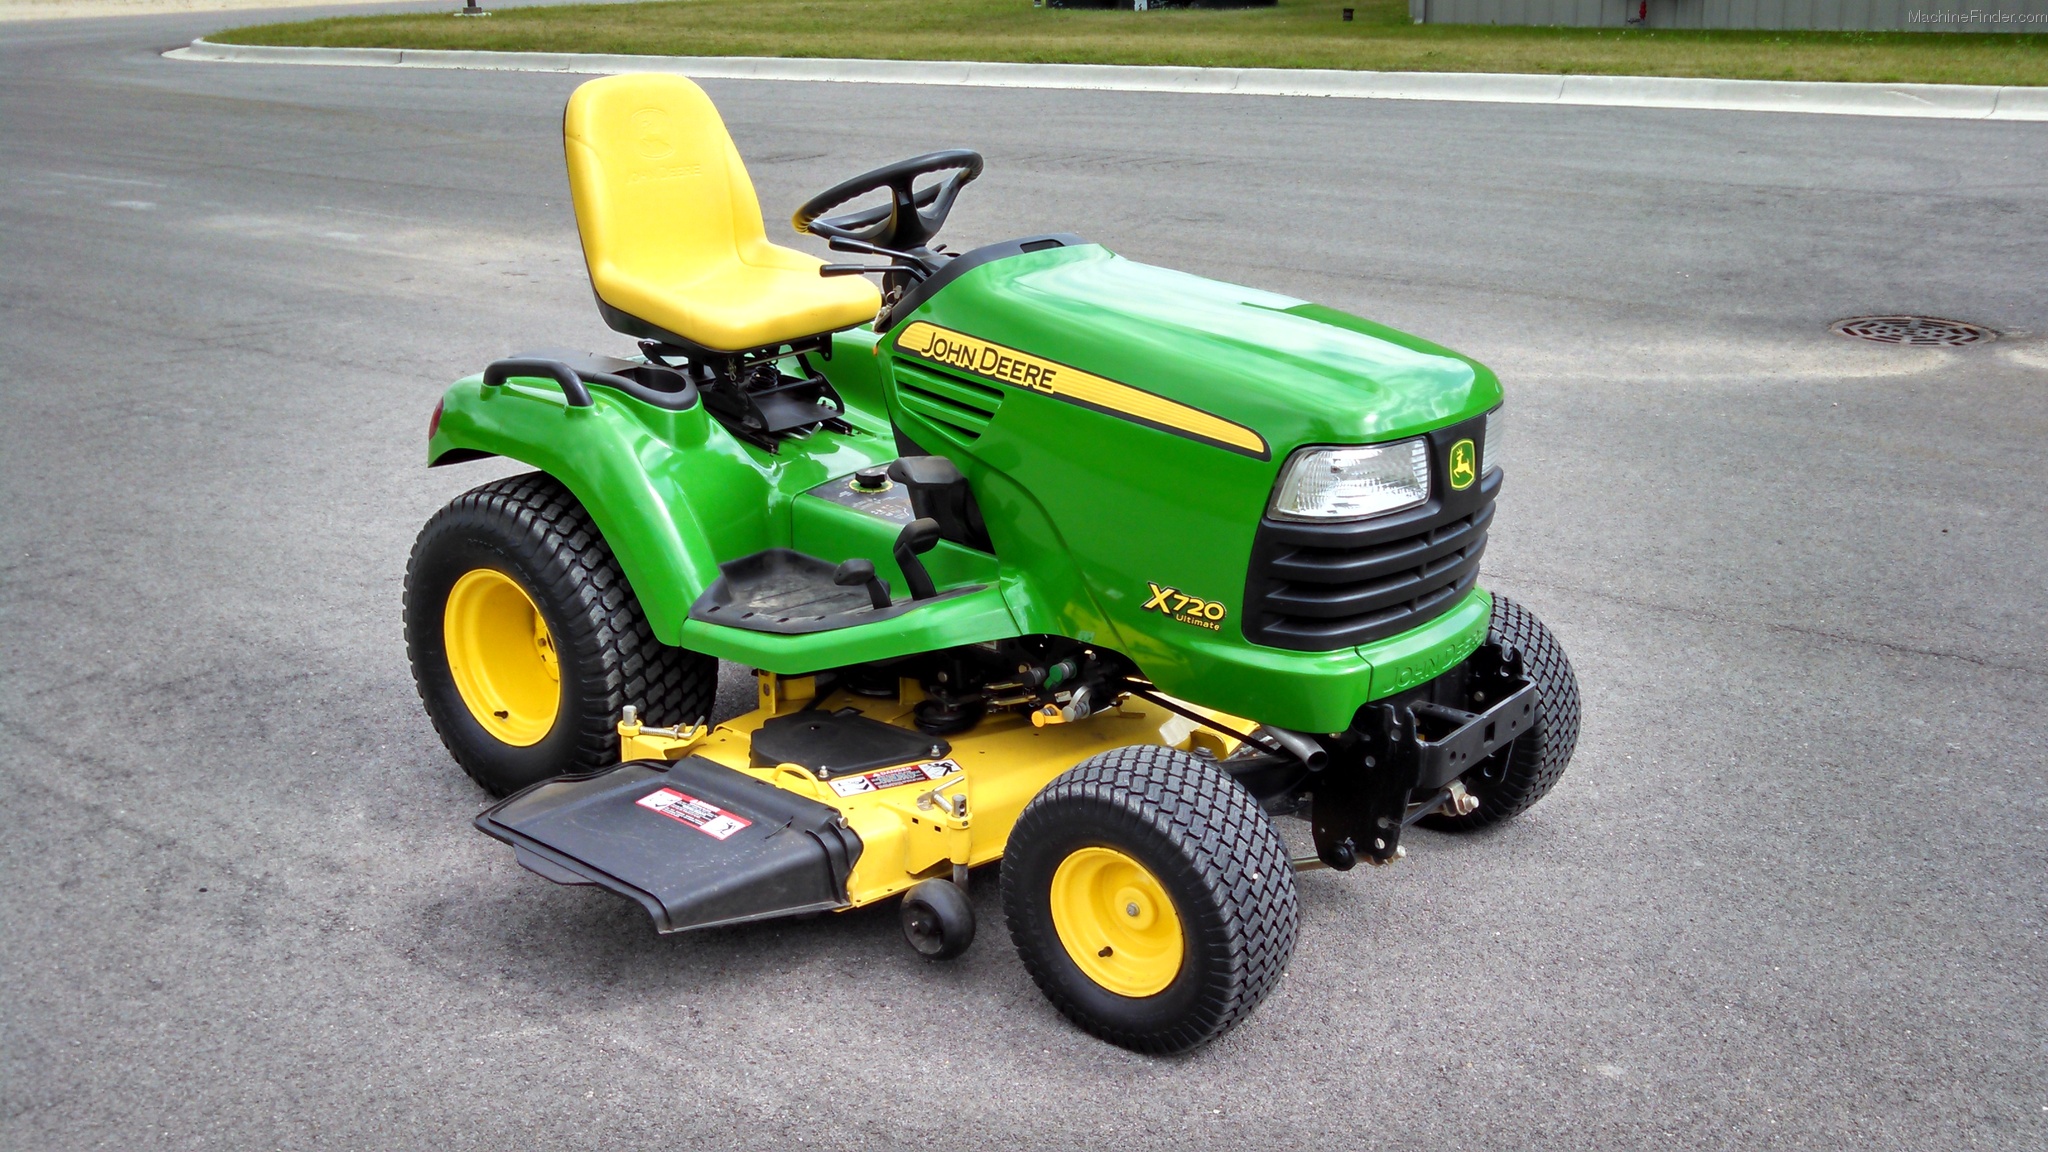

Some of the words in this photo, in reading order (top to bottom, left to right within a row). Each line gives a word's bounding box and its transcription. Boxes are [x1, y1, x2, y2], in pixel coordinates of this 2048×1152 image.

[921, 331, 977, 367] JOHN
[979, 346, 1057, 390] DEERE
[1141, 581, 1226, 621] X720
[1175, 613, 1221, 631] Ultimate
[1382, 654, 1441, 693] JOHN
